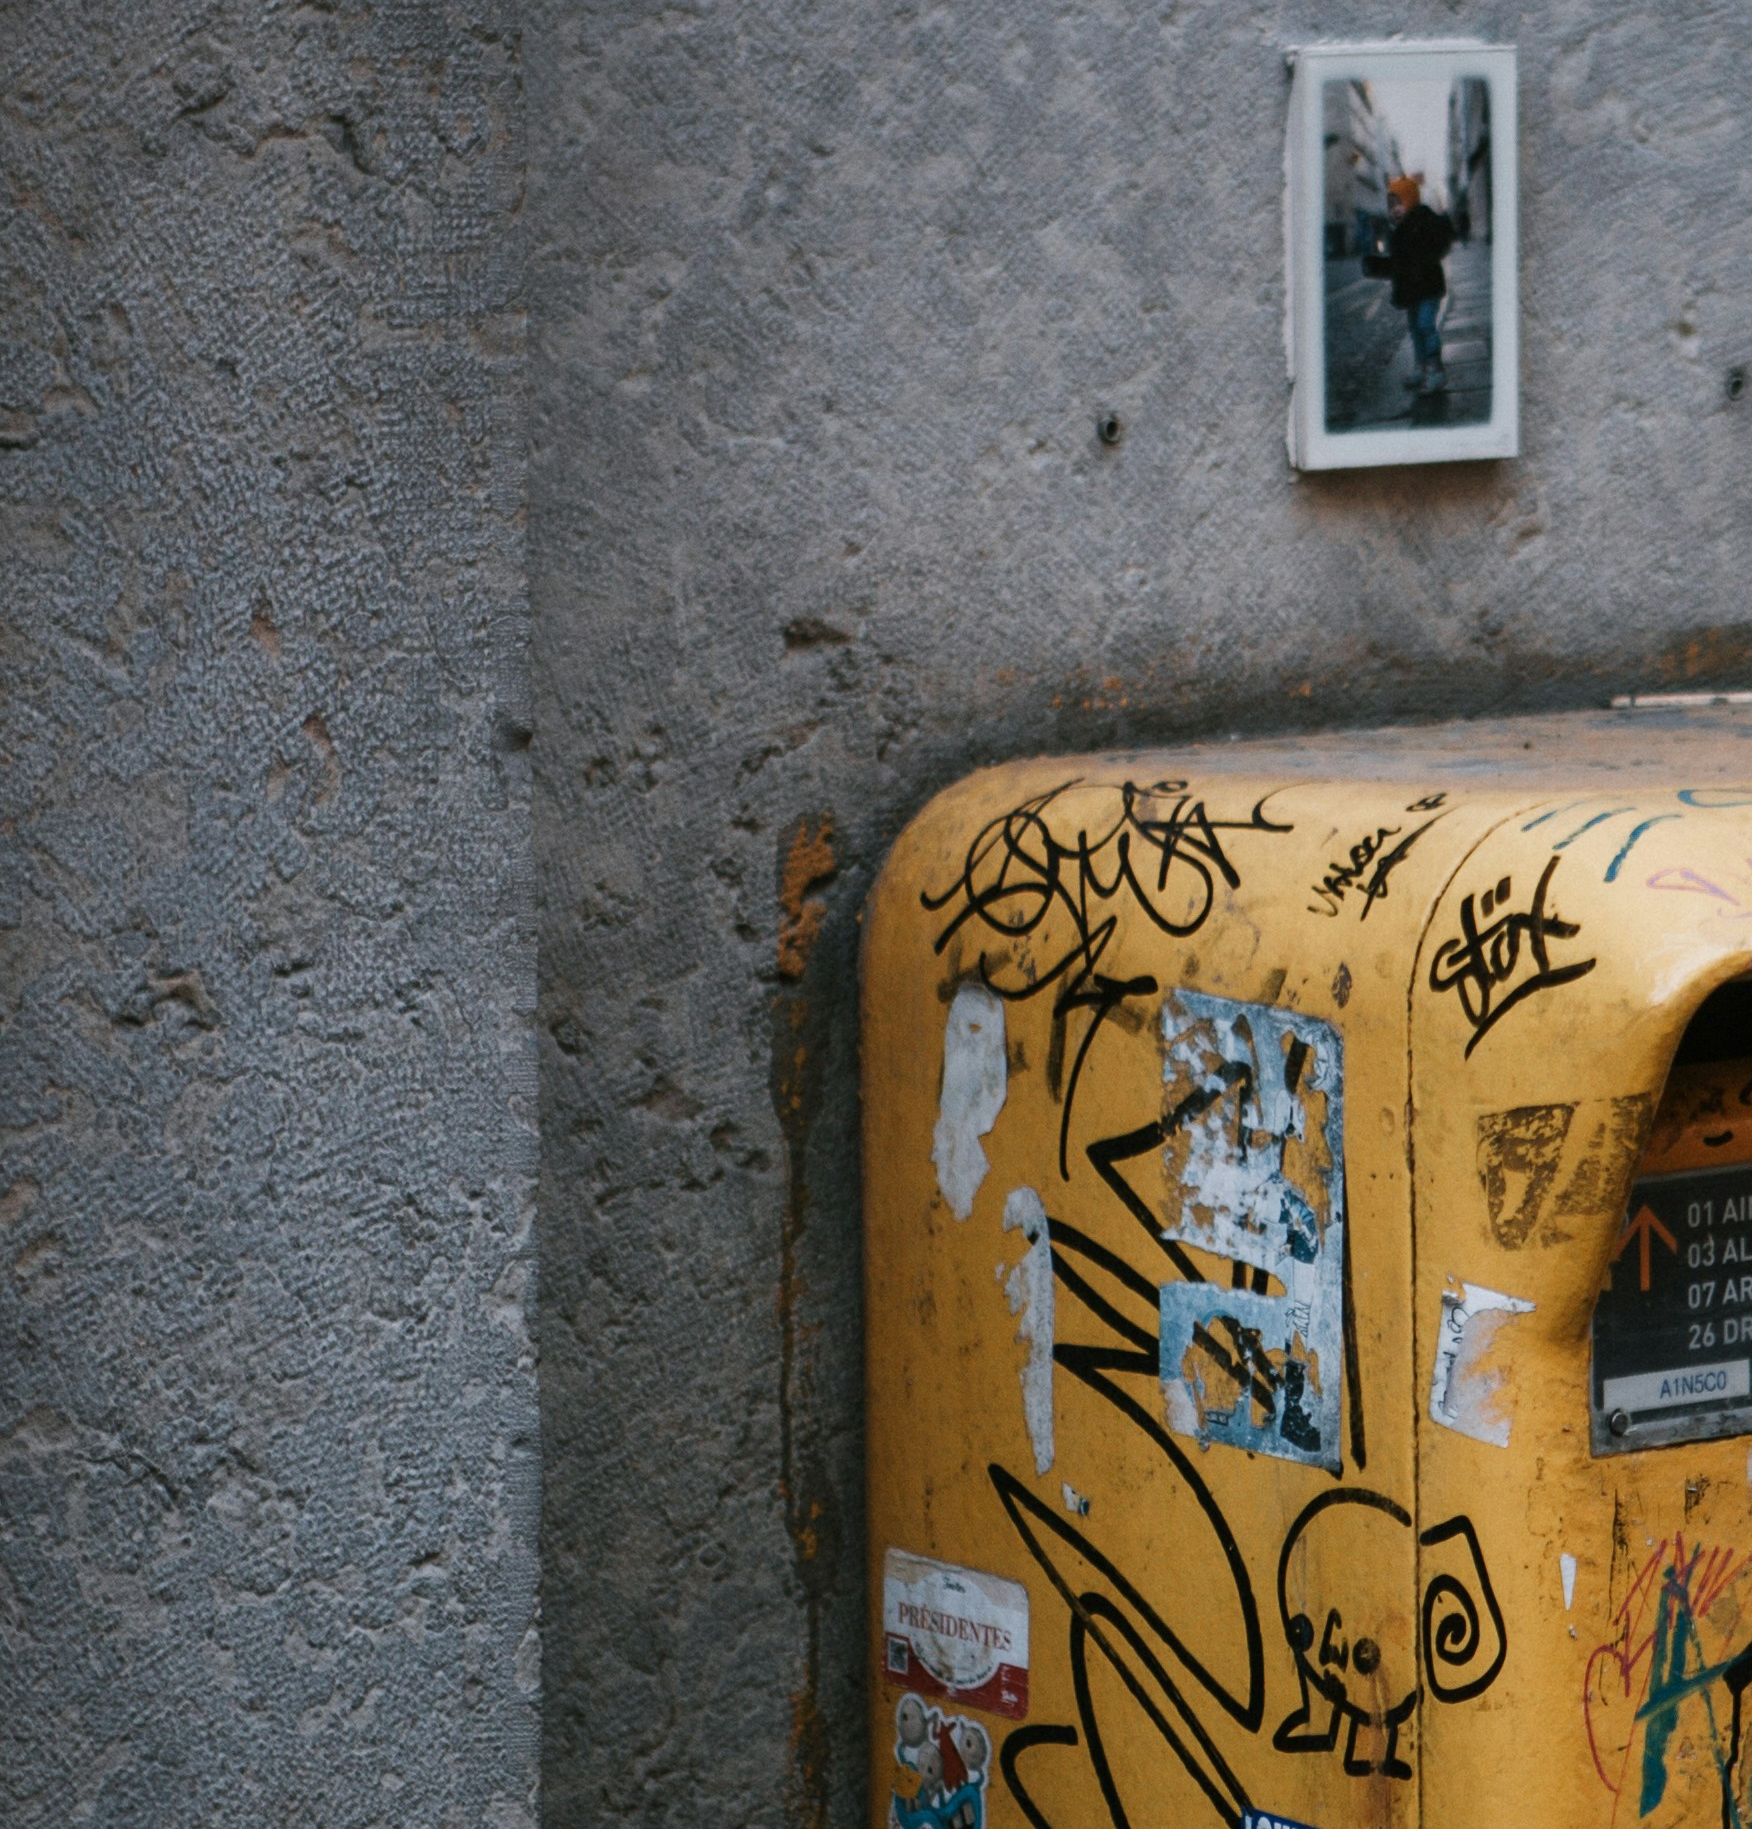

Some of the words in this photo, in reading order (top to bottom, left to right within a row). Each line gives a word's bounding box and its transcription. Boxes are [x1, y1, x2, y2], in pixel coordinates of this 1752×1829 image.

[1687, 1202, 1714, 1228] 01
[1687, 1240, 1715, 1268] 03
[1687, 1282, 1715, 1309] 07
[1688, 1323, 1715, 1350] 26
[897, 1600, 1012, 1652] PRÉSIDENTES
